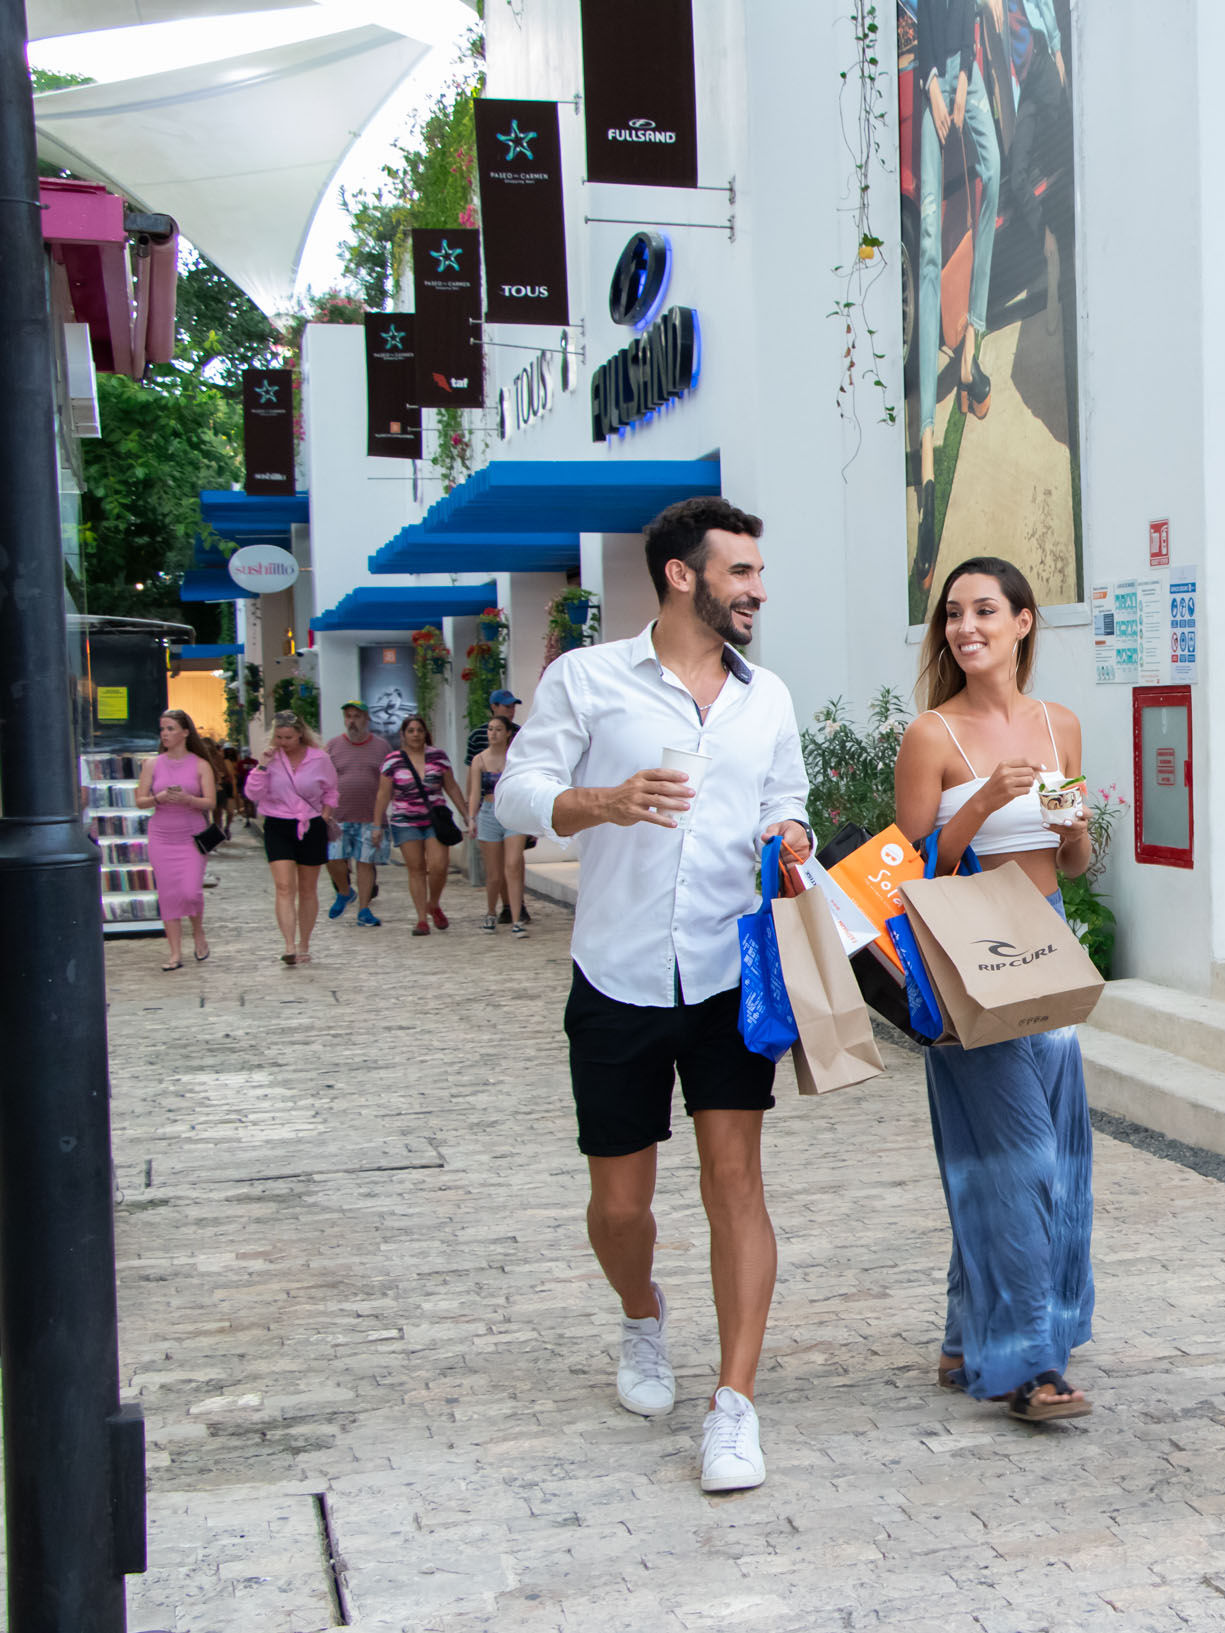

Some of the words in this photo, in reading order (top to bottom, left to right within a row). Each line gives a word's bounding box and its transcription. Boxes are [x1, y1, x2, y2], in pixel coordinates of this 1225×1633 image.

[607, 128, 677, 144] FULLSAND
[501, 285, 550, 298] TOUS
[513, 349, 556, 431] TOUS
[978, 962, 1006, 972] RIP
[1008, 943, 1058, 967] CURL
